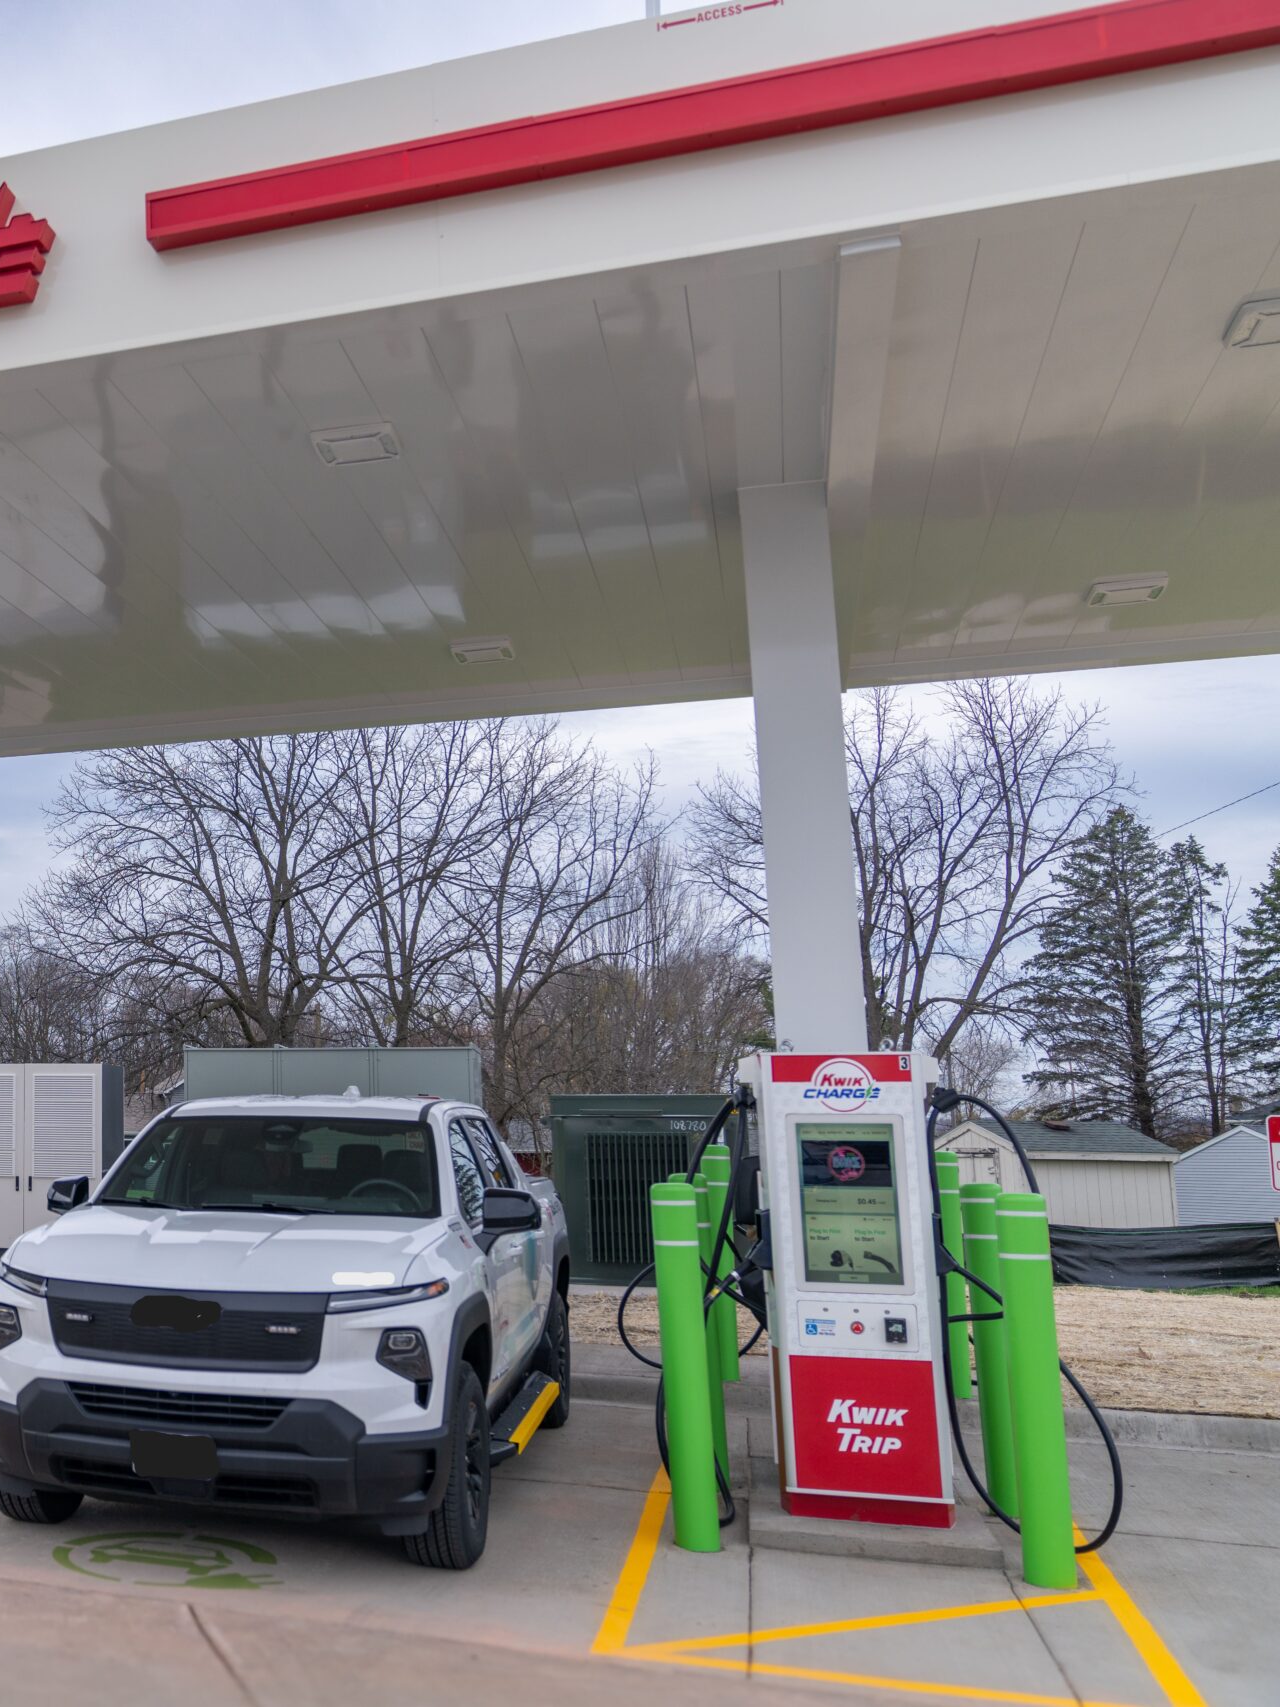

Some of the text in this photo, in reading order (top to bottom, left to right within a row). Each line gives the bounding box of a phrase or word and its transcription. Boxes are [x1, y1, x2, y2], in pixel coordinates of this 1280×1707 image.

[696, 4, 743, 24] ACCESS
[900, 1056, 908, 1070] 3
[820, 1073, 864, 1087] KWIK
[803, 1083, 881, 1102] CHARGE
[670, 1119, 707, 1131] 108780
[826, 1398, 909, 1427] KWIK
[836, 1427, 902, 1455] TRIP
